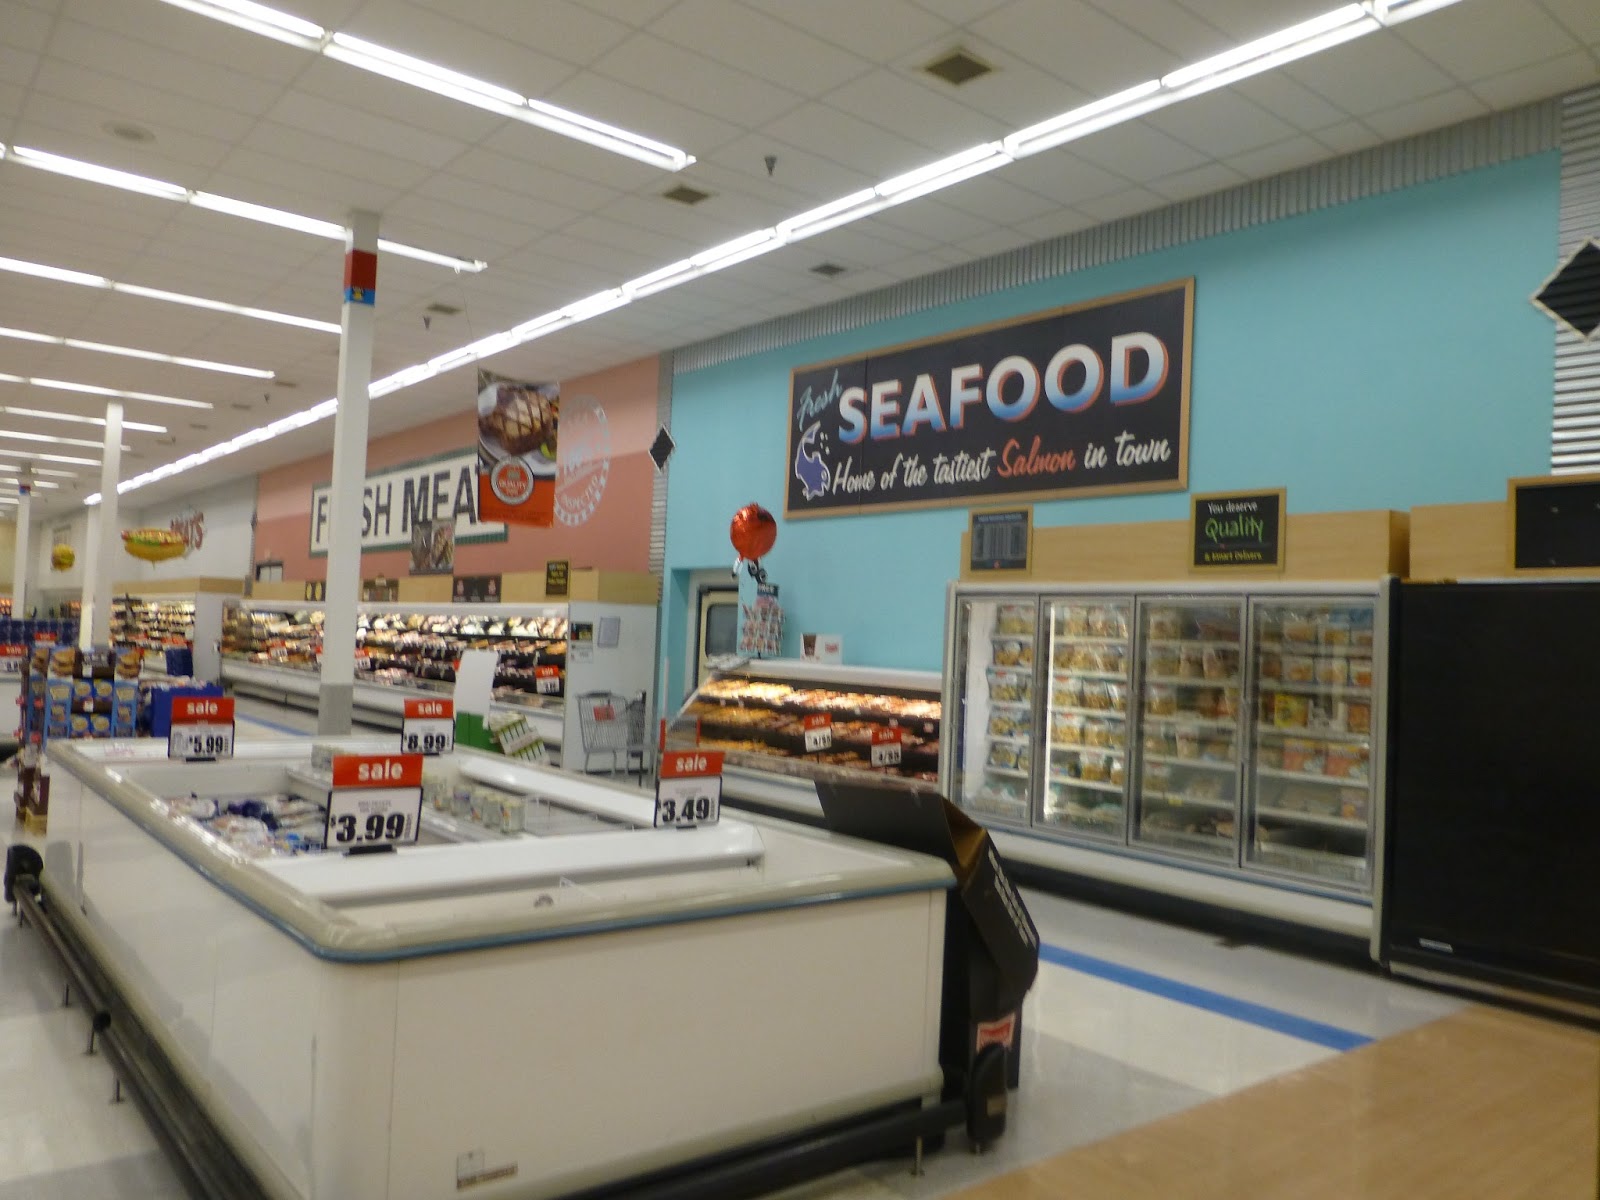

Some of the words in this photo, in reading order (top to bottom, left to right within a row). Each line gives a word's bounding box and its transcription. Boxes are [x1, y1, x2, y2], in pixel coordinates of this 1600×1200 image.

[797, 368, 842, 432] Fresh
[838, 331, 1169, 445] SEAFOOD
[832, 456, 876, 496] Home
[880, 452, 903, 490] of
[903, 454, 928, 488] the
[933, 447, 996, 484] tastiest
[997, 434, 1076, 478] Salmon
[1084, 442, 1108, 470] in
[1114, 429, 1171, 467] town
[316, 481, 393, 544] FSH
[402, 463, 479, 532] MEA
[1207, 502, 1224, 515] You
[1225, 500, 1259, 514] deserve
[1205, 512, 1264, 543] Quality
[187, 700, 218, 716] sale
[418, 701, 443, 716] sale
[357, 758, 403, 781] sale
[675, 753, 708, 773] sale
